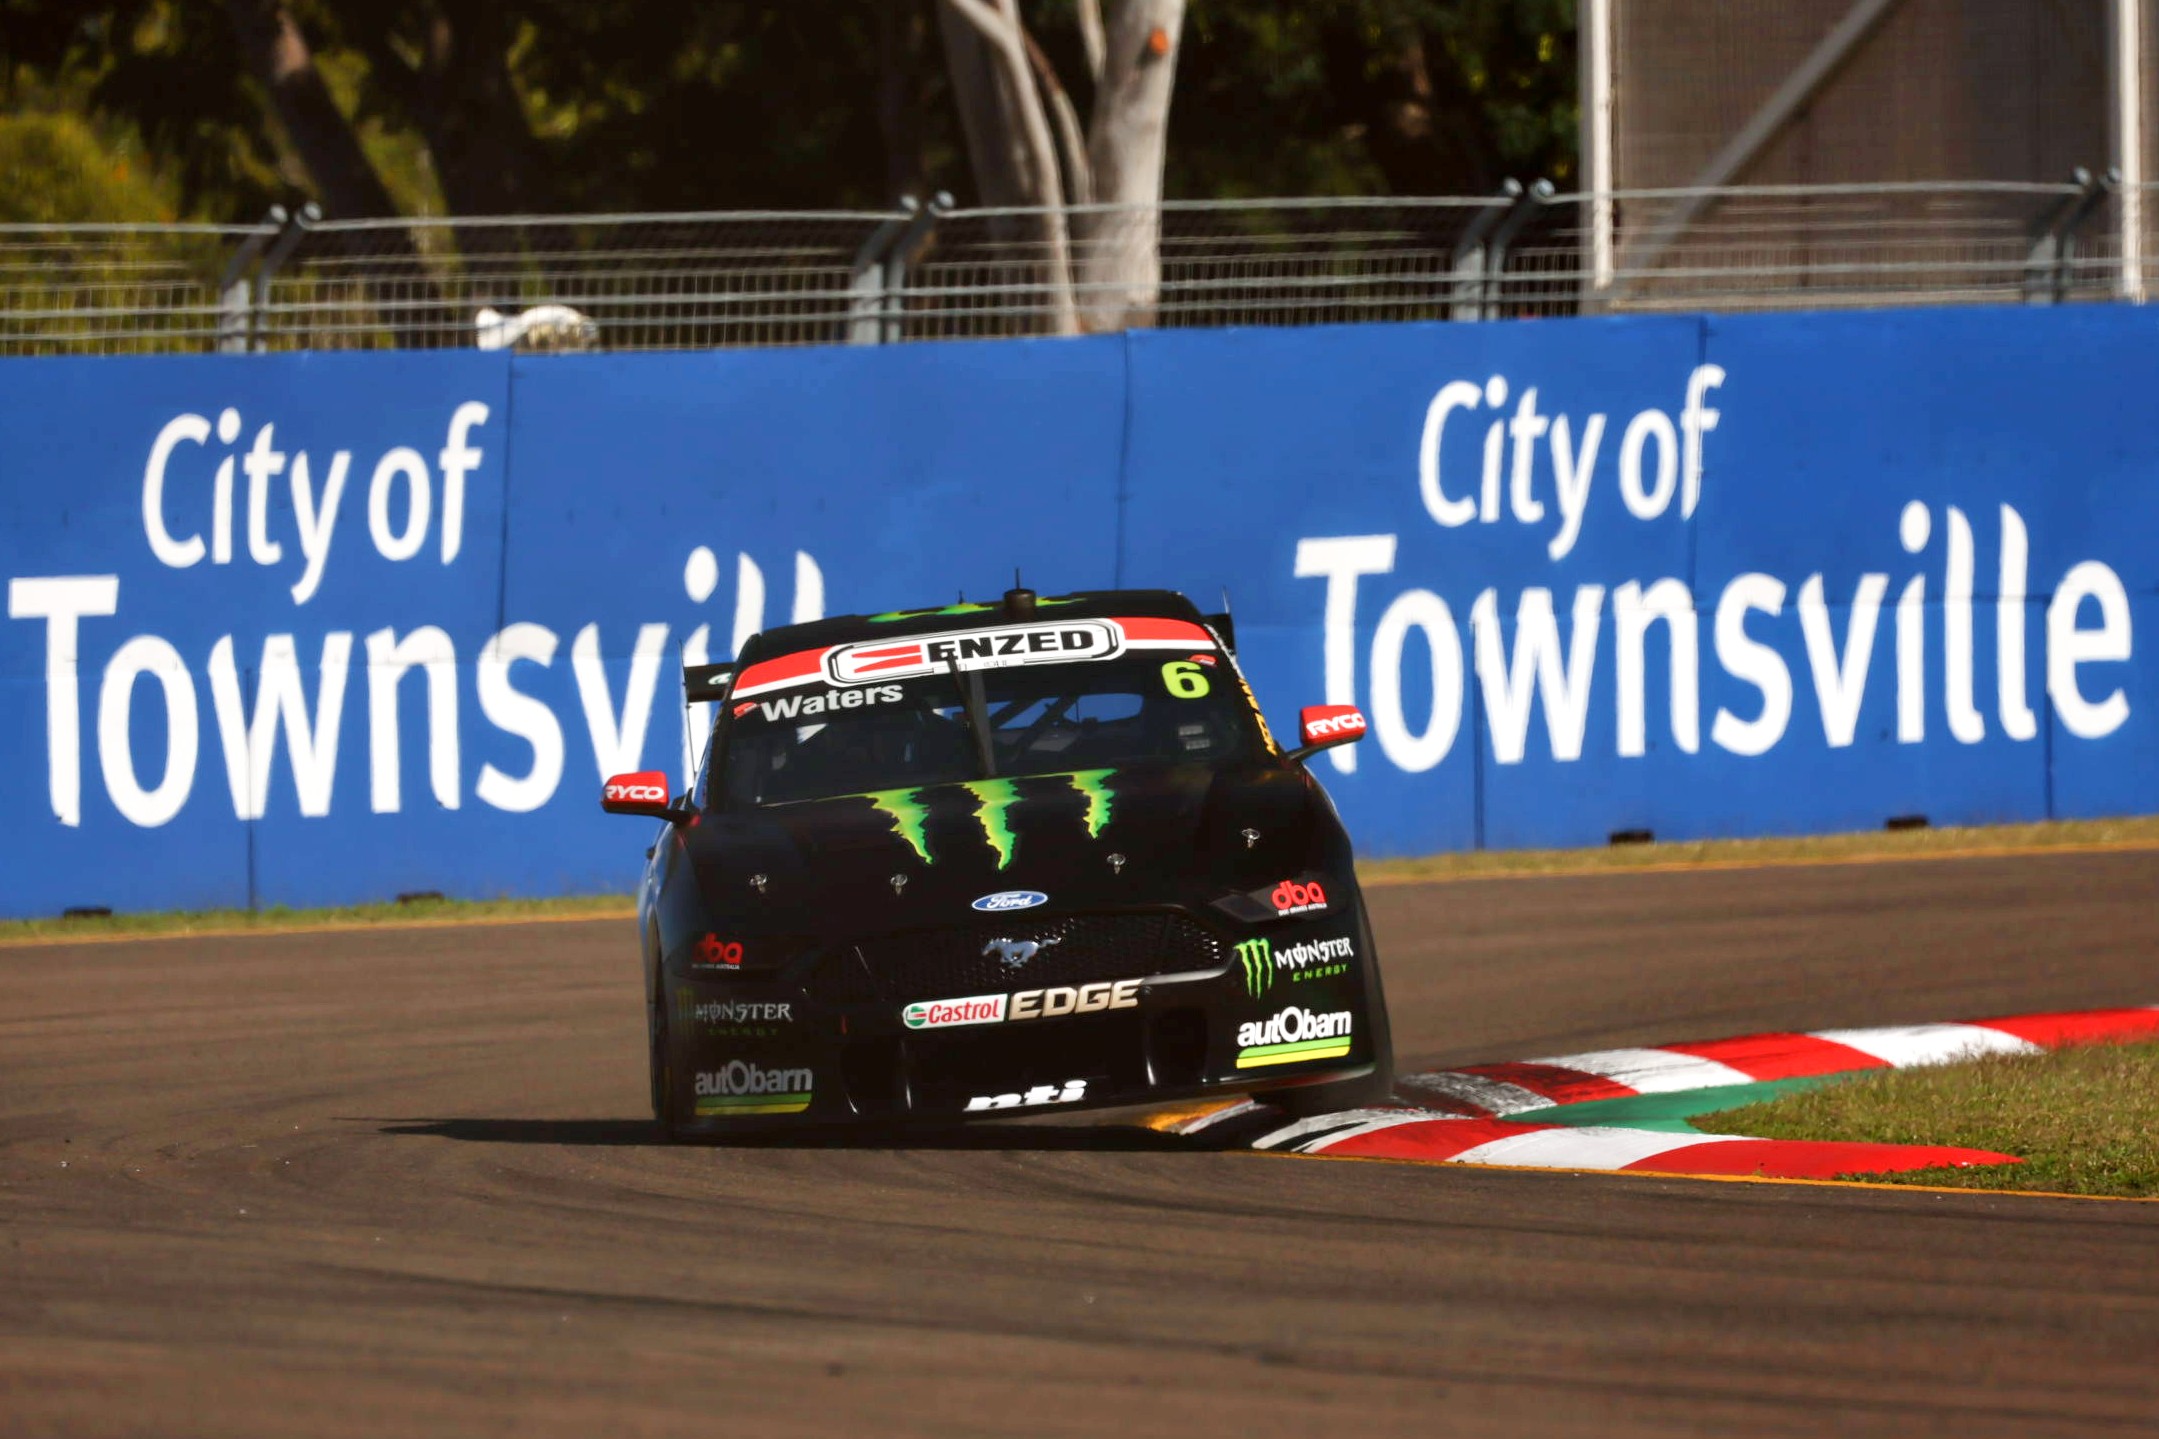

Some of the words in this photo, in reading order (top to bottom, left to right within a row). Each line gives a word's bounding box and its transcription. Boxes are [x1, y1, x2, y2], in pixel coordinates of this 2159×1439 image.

[1418, 375, 1607, 561] City
[1619, 364, 1726, 521] of
[142, 407, 352, 605] City
[368, 400, 490, 566] of
[928, 630, 1094, 663] ENZED
[1293, 500, 2133, 774] Townsville
[1161, 660, 1210, 699] 6
[760, 684, 904, 722] Waters
[1306, 712, 1367, 737] RYCO
[605, 784, 666, 800] RYCO
[986, 893, 1034, 909] Ford
[1271, 880, 1327, 910] dba
[1274, 937, 1354, 971] MONSTER
[1293, 963, 1349, 983] ENERGY
[928, 998, 1000, 1025] Castrol
[1008, 978, 1145, 1021] EDGE
